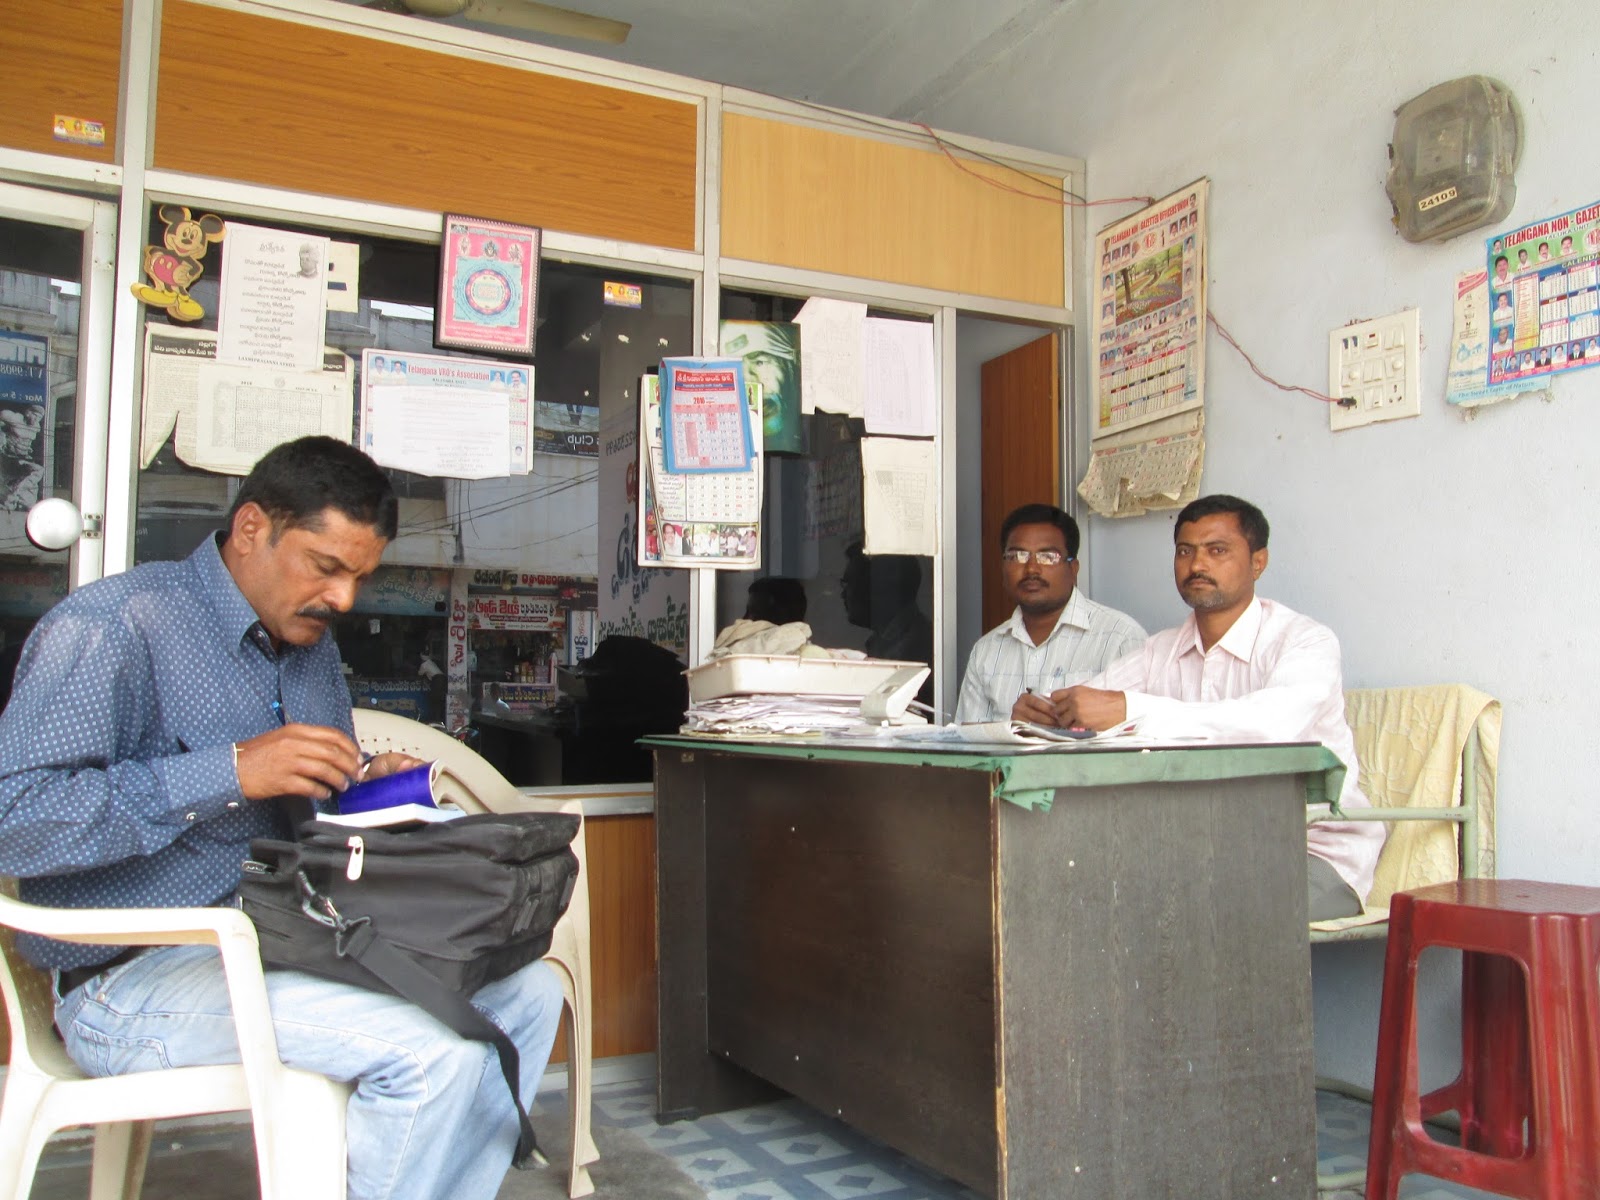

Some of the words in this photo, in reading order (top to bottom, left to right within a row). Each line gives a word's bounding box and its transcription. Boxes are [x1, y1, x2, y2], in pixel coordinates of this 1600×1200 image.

[1420, 189, 1456, 209] 24109
[1504, 222, 1549, 248] TELANGANA
[1551, 216, 1569, 233] NON
[408, 364, 437, 376] Telangana
[456, 369, 489, 381] Association
[1470, 389, 1488, 397] Sweet
[1505, 383, 1513, 391] of
[1513, 381, 1535, 389] Nature
